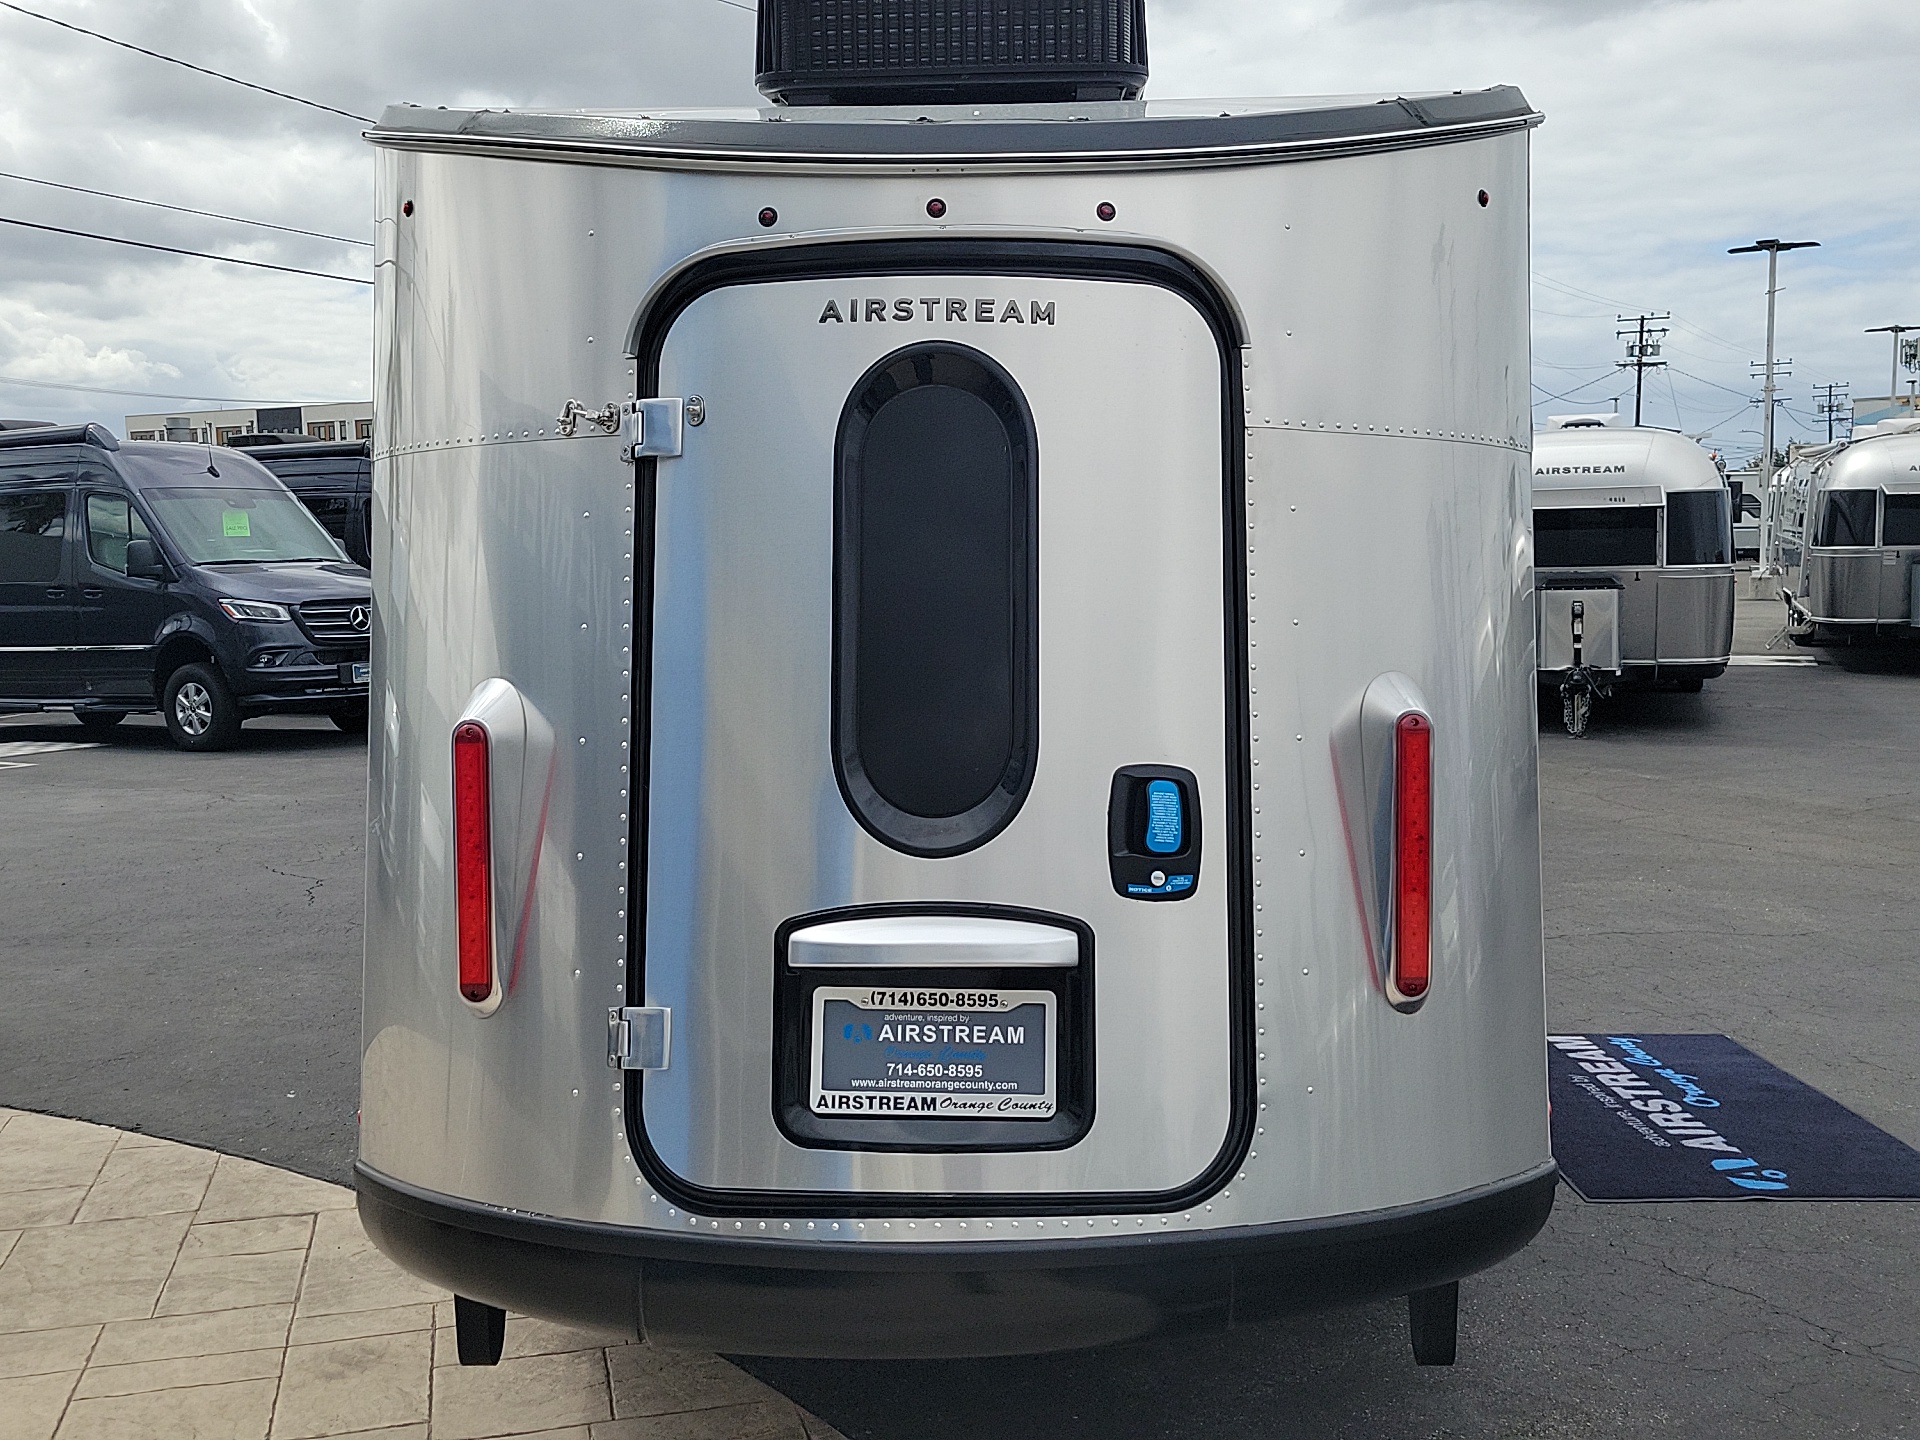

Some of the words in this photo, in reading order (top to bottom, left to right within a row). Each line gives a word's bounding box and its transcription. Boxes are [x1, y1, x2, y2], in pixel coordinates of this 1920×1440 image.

[819, 297, 1055, 325] AIRSTREAM
[1535, 466, 1625, 475] AIRSTREAM
[870, 991, 999, 1008] (714)650-8595
[927, 1014, 958, 1022] inspired
[959, 1014, 970, 1024] by
[878, 1024, 1024, 1044] AIRSTREAM
[884, 1046, 933, 1062] Orange
[939, 1045, 987, 1062] County
[1606, 1036, 1663, 1067] County
[886, 1063, 983, 1078] 714-650-8595
[851, 1078, 1018, 1091] www.airstreamorangecounty.com
[1654, 1068, 1721, 1108] Orange
[1546, 1035, 1742, 1153] AIRSTREAM
[816, 1095, 937, 1112] AIRSTREAM
[939, 1097, 994, 1113] Orange
[997, 1098, 1054, 1113] County
